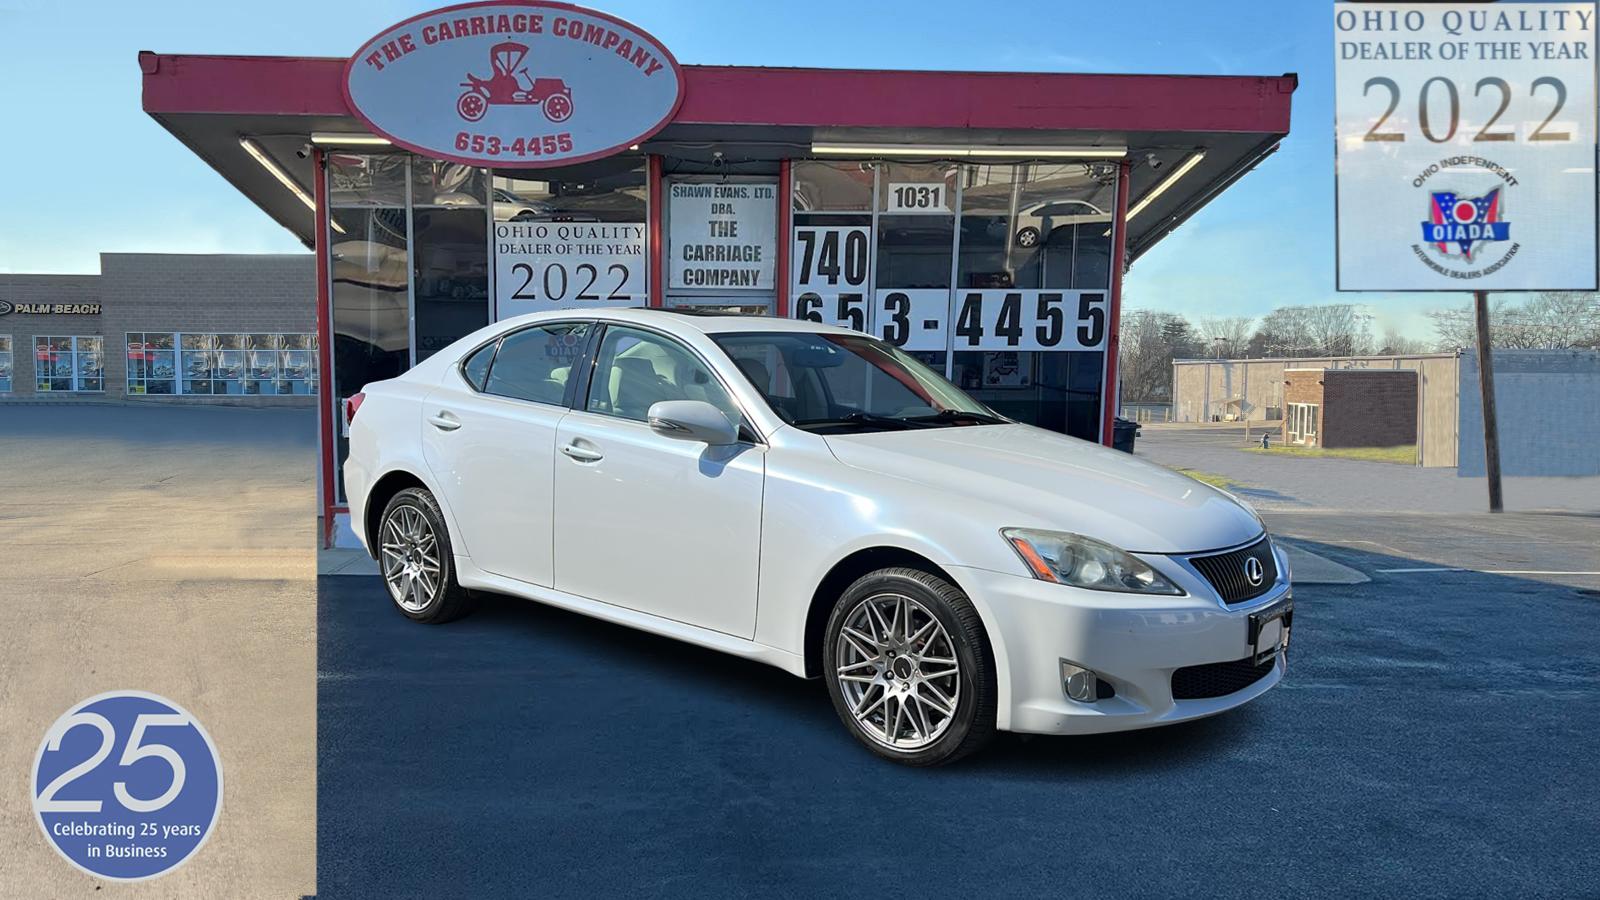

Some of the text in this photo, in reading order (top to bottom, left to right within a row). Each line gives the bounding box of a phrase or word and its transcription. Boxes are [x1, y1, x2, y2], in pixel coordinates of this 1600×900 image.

[1336, 9, 1593, 36] OHIO QUALITY
[365, 14, 664, 77] THE CARRIAGE COMPANY
[1340, 41, 1590, 60] DEALER OF THE YEAR
[1362, 75, 1571, 144] 2022
[454, 131, 574, 157] 653-4455
[1412, 156, 1519, 189] OHIO INDEPENDENT
[672, 186, 712, 199] SHAWN
[754, 186, 775, 200] LTD.
[894, 186, 940, 209] 1031
[711, 203, 736, 216] DBA.
[496, 225, 644, 242] OHIO QUALITY
[708, 220, 738, 238] THE
[1432, 224, 1495, 241] OIADA
[499, 243, 642, 255] DEALER OF THE YEAR
[682, 244, 763, 263] CARRIAGE
[797, 230, 868, 286] 740
[1410, 242, 1521, 281] AUTOMOBILE DEALERS ASSOCIATION
[511, 262, 632, 301] 2022
[683, 268, 761, 287] COMPANY
[14, 304, 100, 314] PALM BEACH
